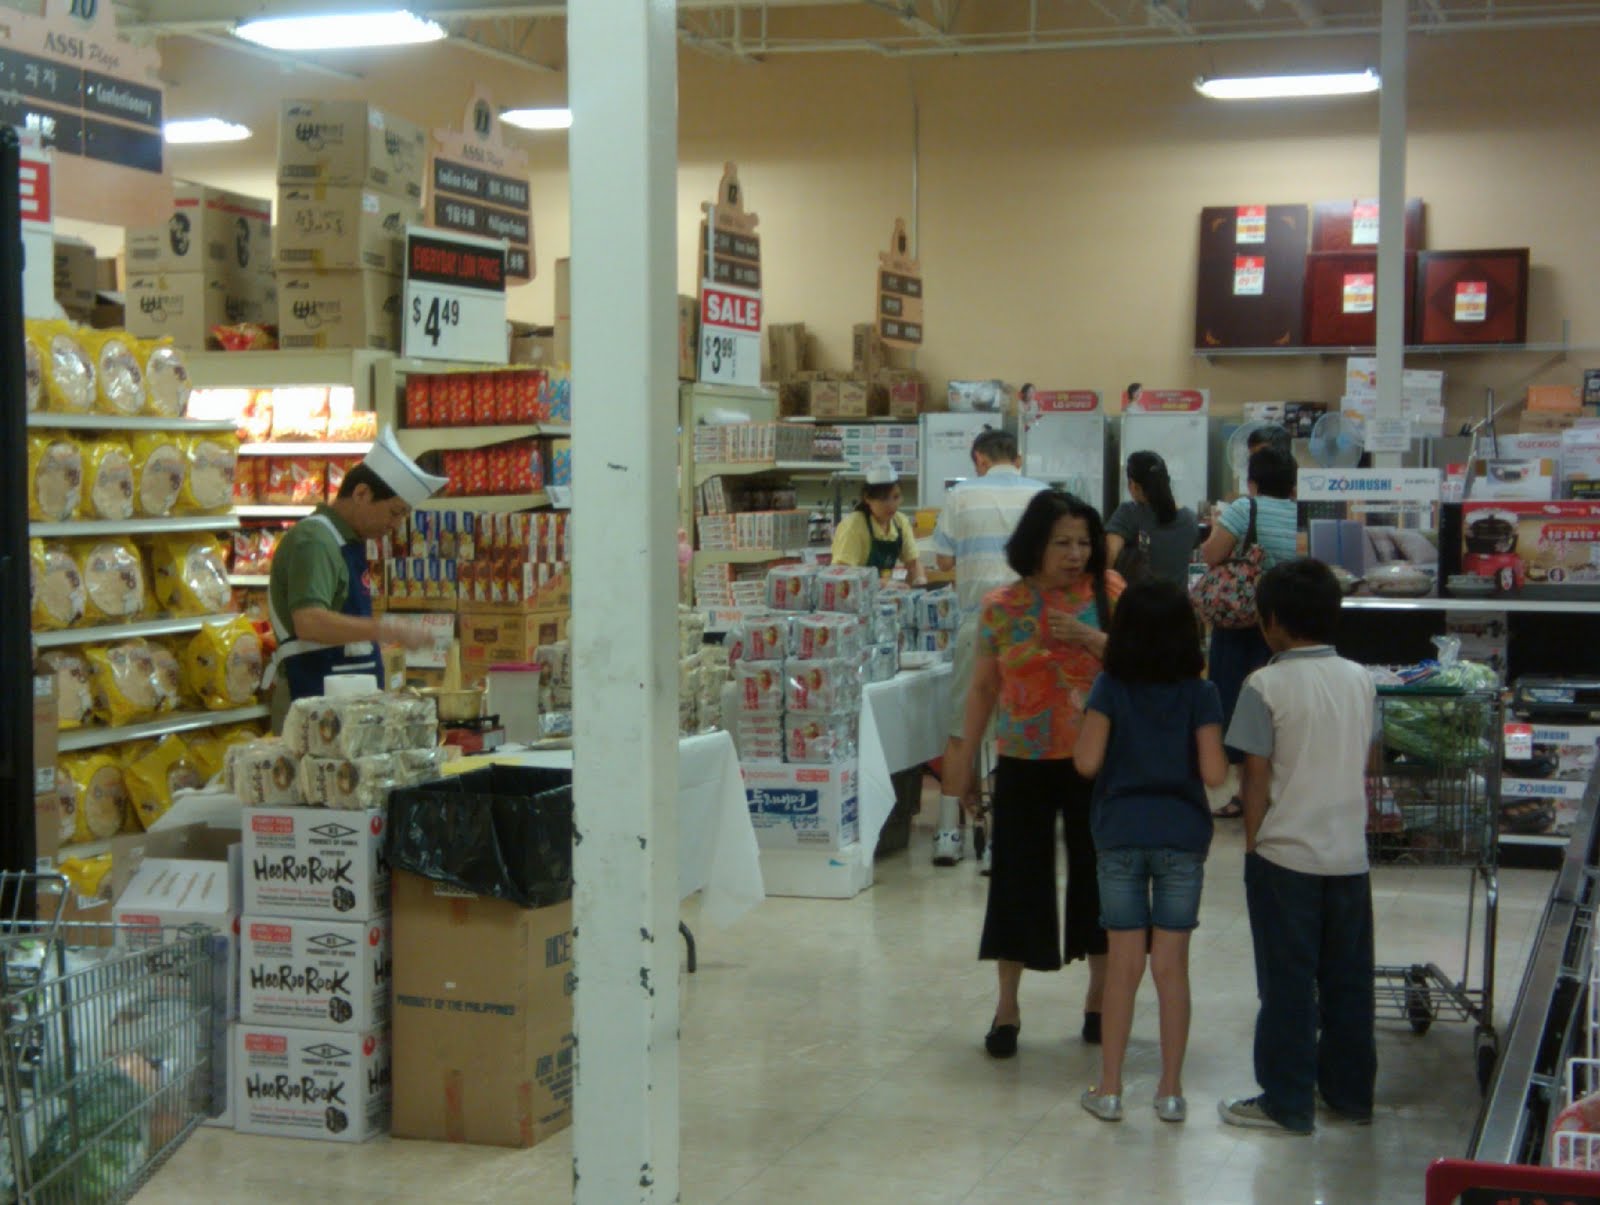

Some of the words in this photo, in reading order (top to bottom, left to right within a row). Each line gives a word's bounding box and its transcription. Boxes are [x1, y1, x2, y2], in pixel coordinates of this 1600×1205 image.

[44, 32, 84, 59] ASSI
[707, 294, 758, 327] SALE
[1328, 477, 1392, 493] ZOJIRUSHI
[397, 994, 432, 1008] PRODUCT
[434, 999, 444, 1009] OF
[448, 1000, 462, 1011] THE
